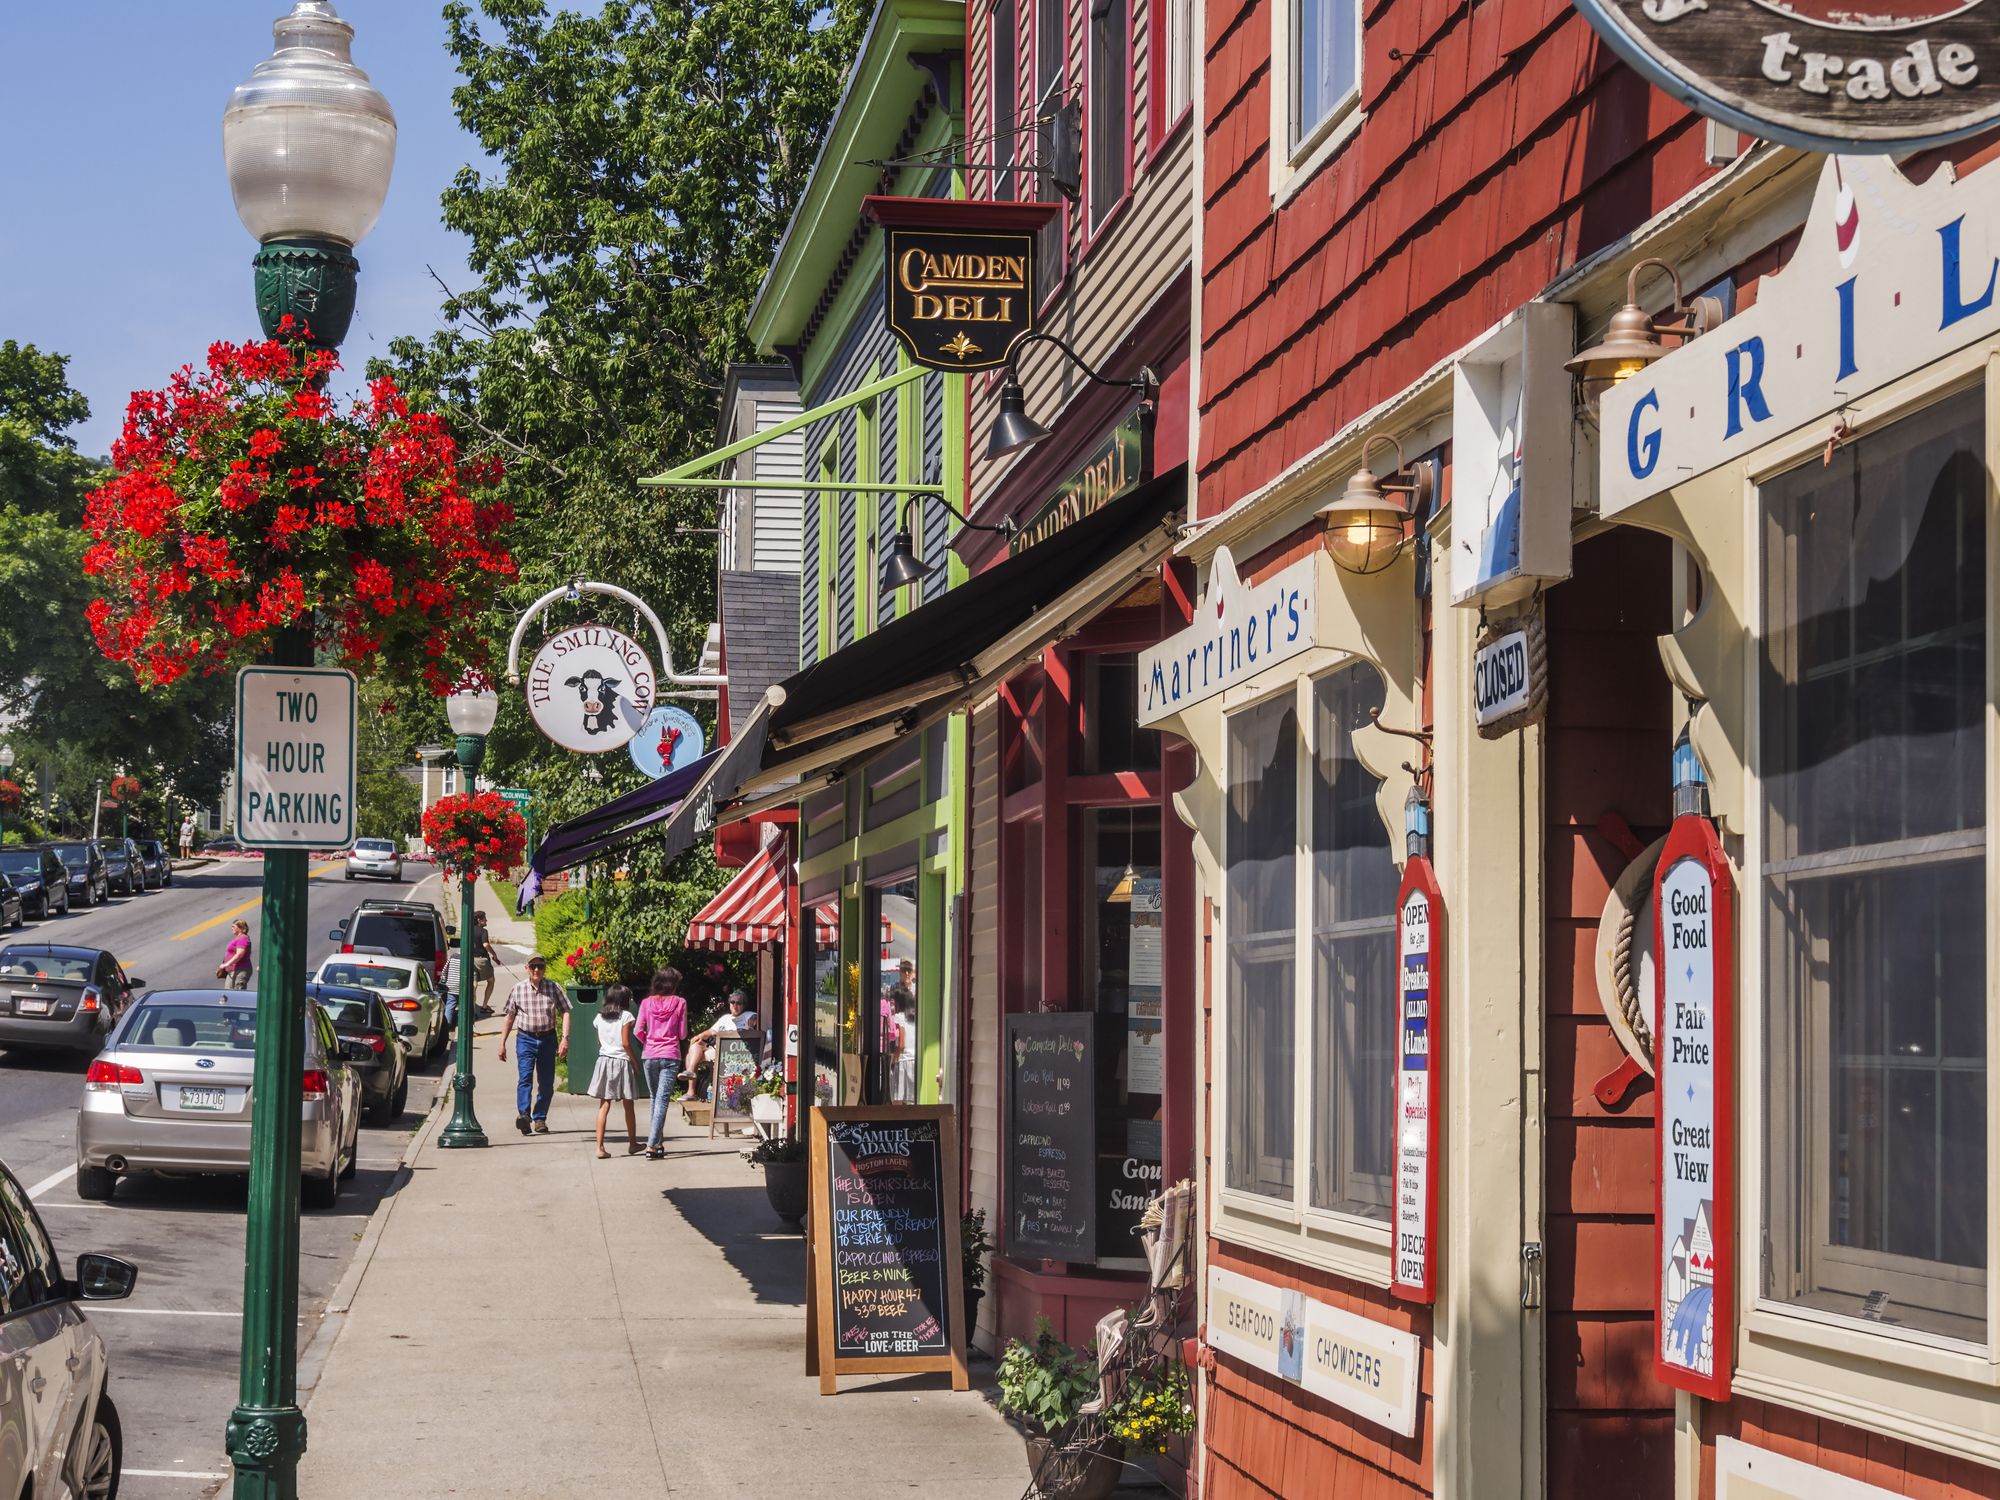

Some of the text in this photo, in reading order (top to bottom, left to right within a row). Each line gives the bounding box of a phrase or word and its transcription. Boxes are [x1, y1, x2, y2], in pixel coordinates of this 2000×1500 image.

[1761, 32, 1979, 99] trade
[899, 248, 1026, 292] CAMDEN
[912, 295, 1012, 322] DELI
[1084, 438, 1126, 516] DELI
[1148, 588, 1299, 711] Marriner's
[532, 629, 650, 716] THE SMILING COW
[1476, 641, 1524, 712] CLOSED
[276, 691, 318, 724] TWO
[266, 742, 325, 775] HOUR
[248, 791, 342, 825] PARKING
[1671, 885, 1707, 917] Good
[1406, 903, 1429, 927] OPEN
[1672, 920, 1708, 950] Food
[1675, 1002, 1705, 1030] Fair
[1672, 1036, 1710, 1065] Price
[851, 1127, 915, 1145] SAMUEL
[1672, 1118, 1711, 1150] Great
[856, 1141, 911, 1159] ADAMS
[856, 1158, 908, 1171] BOSTON LAGER
[1673, 1152, 1710, 1184] View
[834, 1176, 853, 1192] THE
[847, 1193, 860, 1205] IS
[836, 1208, 910, 1222] OUR FRIENDLY
[895, 1221, 904, 1231] IS
[905, 1217, 938, 1231] READY
[838, 1232, 902, 1246] TO SERVE YOU
[1401, 1232, 1425, 1256] DECK
[840, 1269, 870, 1285] BEER
[883, 1268, 914, 1281] WINE
[1401, 1258, 1425, 1281] OPEN
[842, 1288, 921, 1309] HAPPY HOUR 4-7
[877, 1303, 908, 1317] BEER
[1228, 1301, 1274, 1341] SEAFOOD
[865, 1340, 888, 1353] LOVE
[894, 1340, 919, 1352] BEER
[870, 1330, 913, 1340] FOR THE
[1316, 1337, 1381, 1388] CHOWDERS
